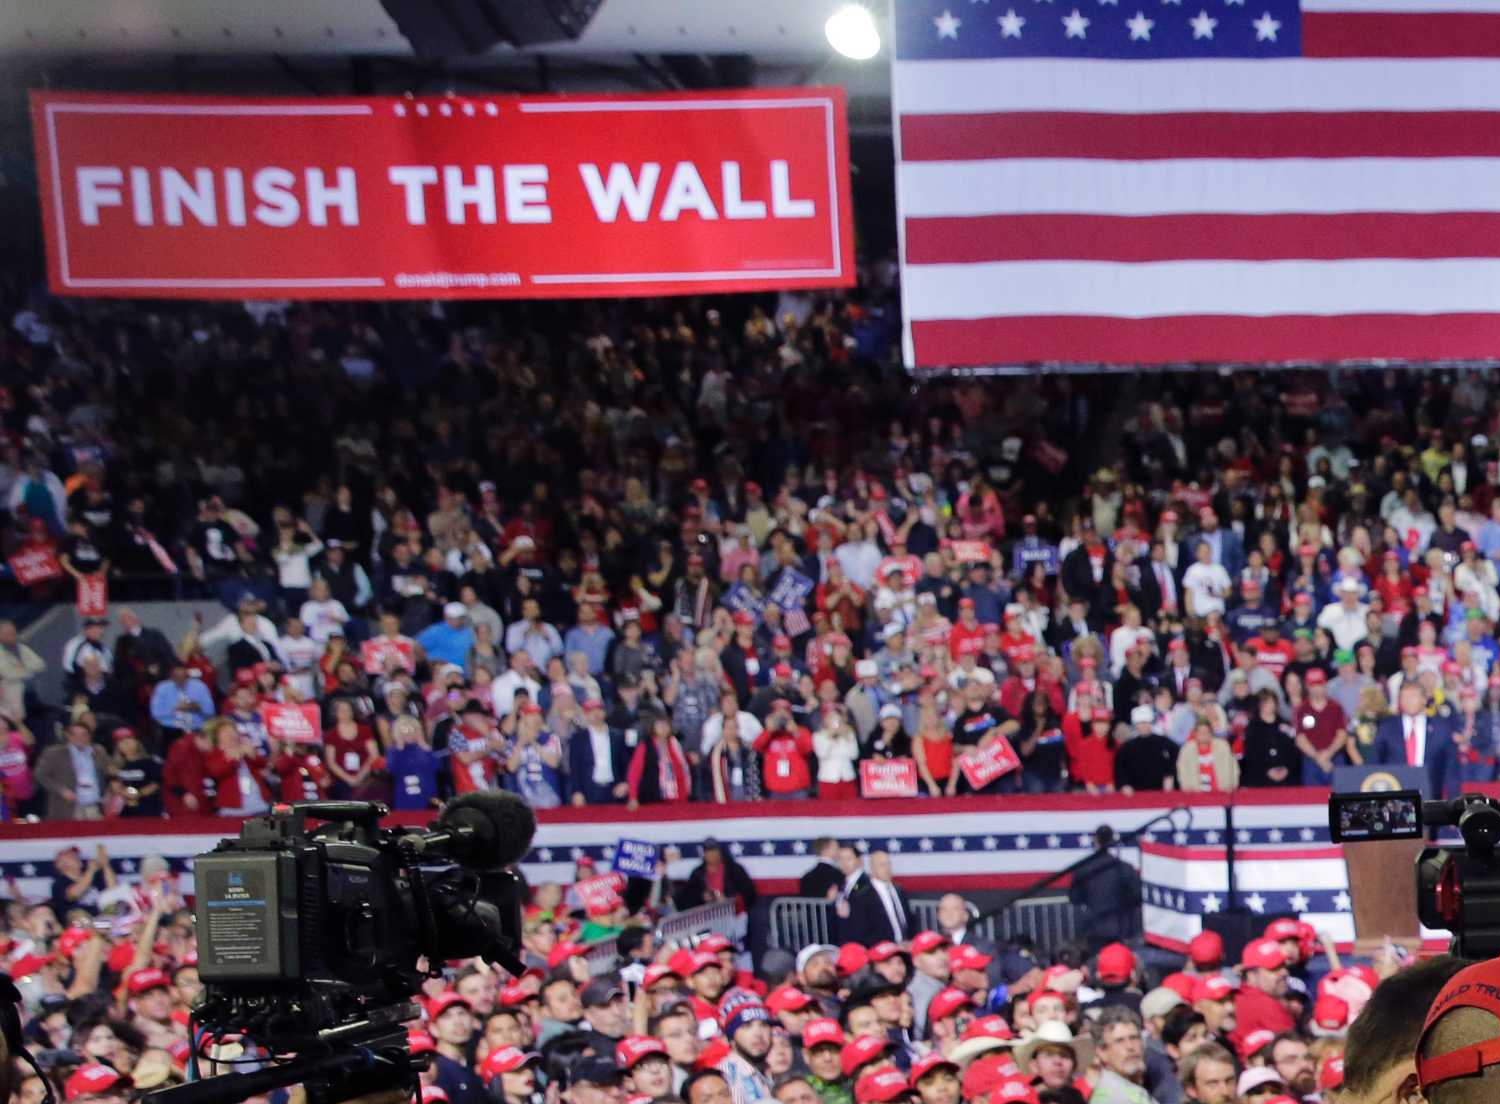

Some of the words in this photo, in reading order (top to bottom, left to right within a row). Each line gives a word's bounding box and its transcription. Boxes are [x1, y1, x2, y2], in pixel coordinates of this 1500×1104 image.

[77, 168, 360, 226] FINISH
[389, 165, 553, 225] THE
[579, 160, 817, 223] WALL
